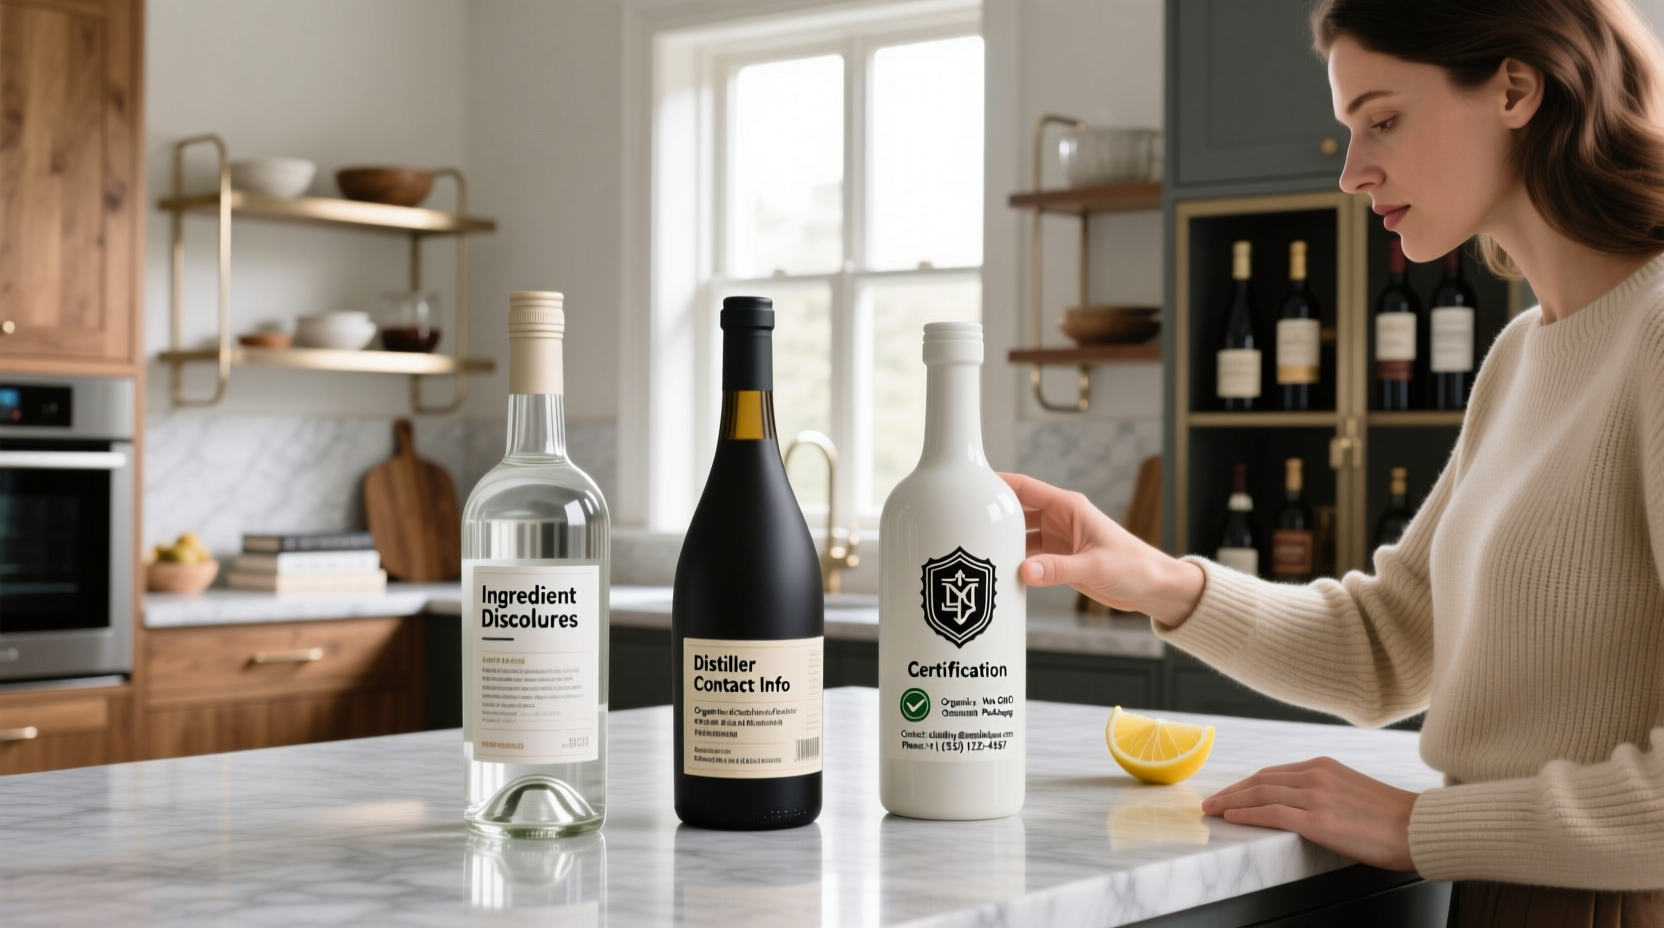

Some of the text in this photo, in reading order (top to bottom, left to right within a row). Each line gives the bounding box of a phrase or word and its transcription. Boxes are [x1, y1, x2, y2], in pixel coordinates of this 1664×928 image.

[482, 585, 577, 609] Ingredient
[481, 608, 579, 629] Discolures
[693, 655, 757, 673] Distiller
[907, 660, 1007, 678] Certification
[693, 676, 791, 693] Contact Info
